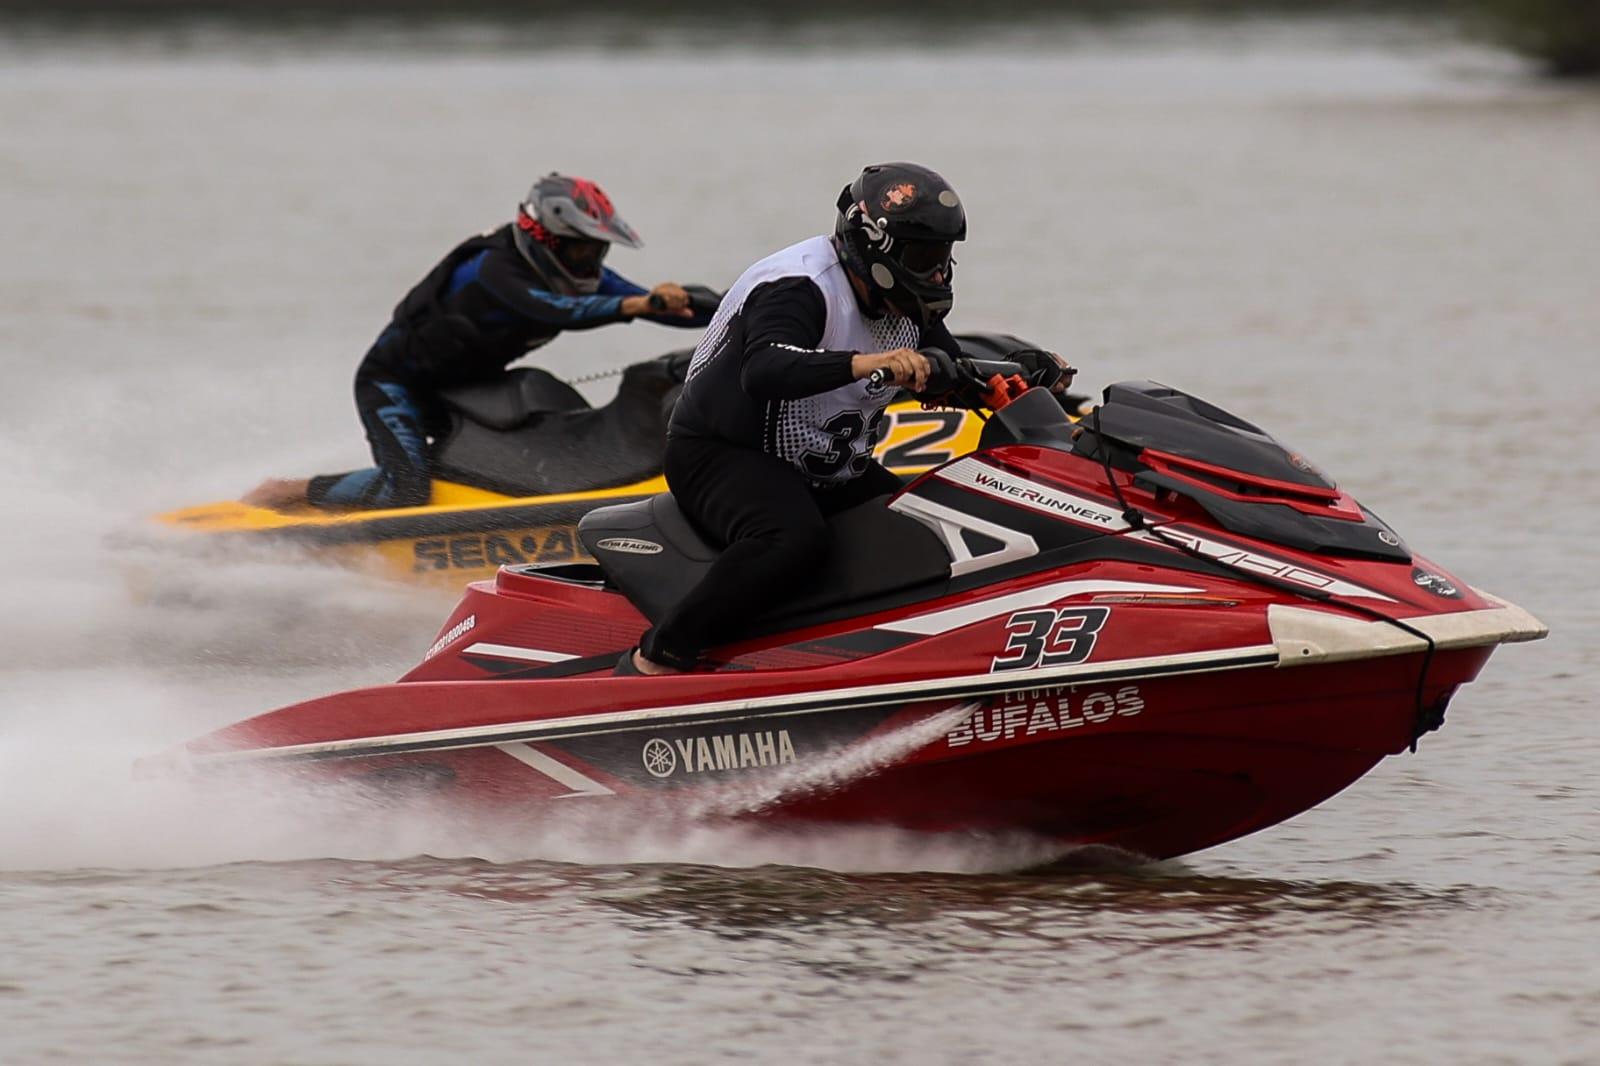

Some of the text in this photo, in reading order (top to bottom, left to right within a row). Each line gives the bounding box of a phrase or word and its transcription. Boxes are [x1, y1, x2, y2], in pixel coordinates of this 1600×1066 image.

[990, 606, 1111, 674] 33
[948, 686, 1145, 748] BUFALOS
[675, 729, 797, 773] YAMAHA
